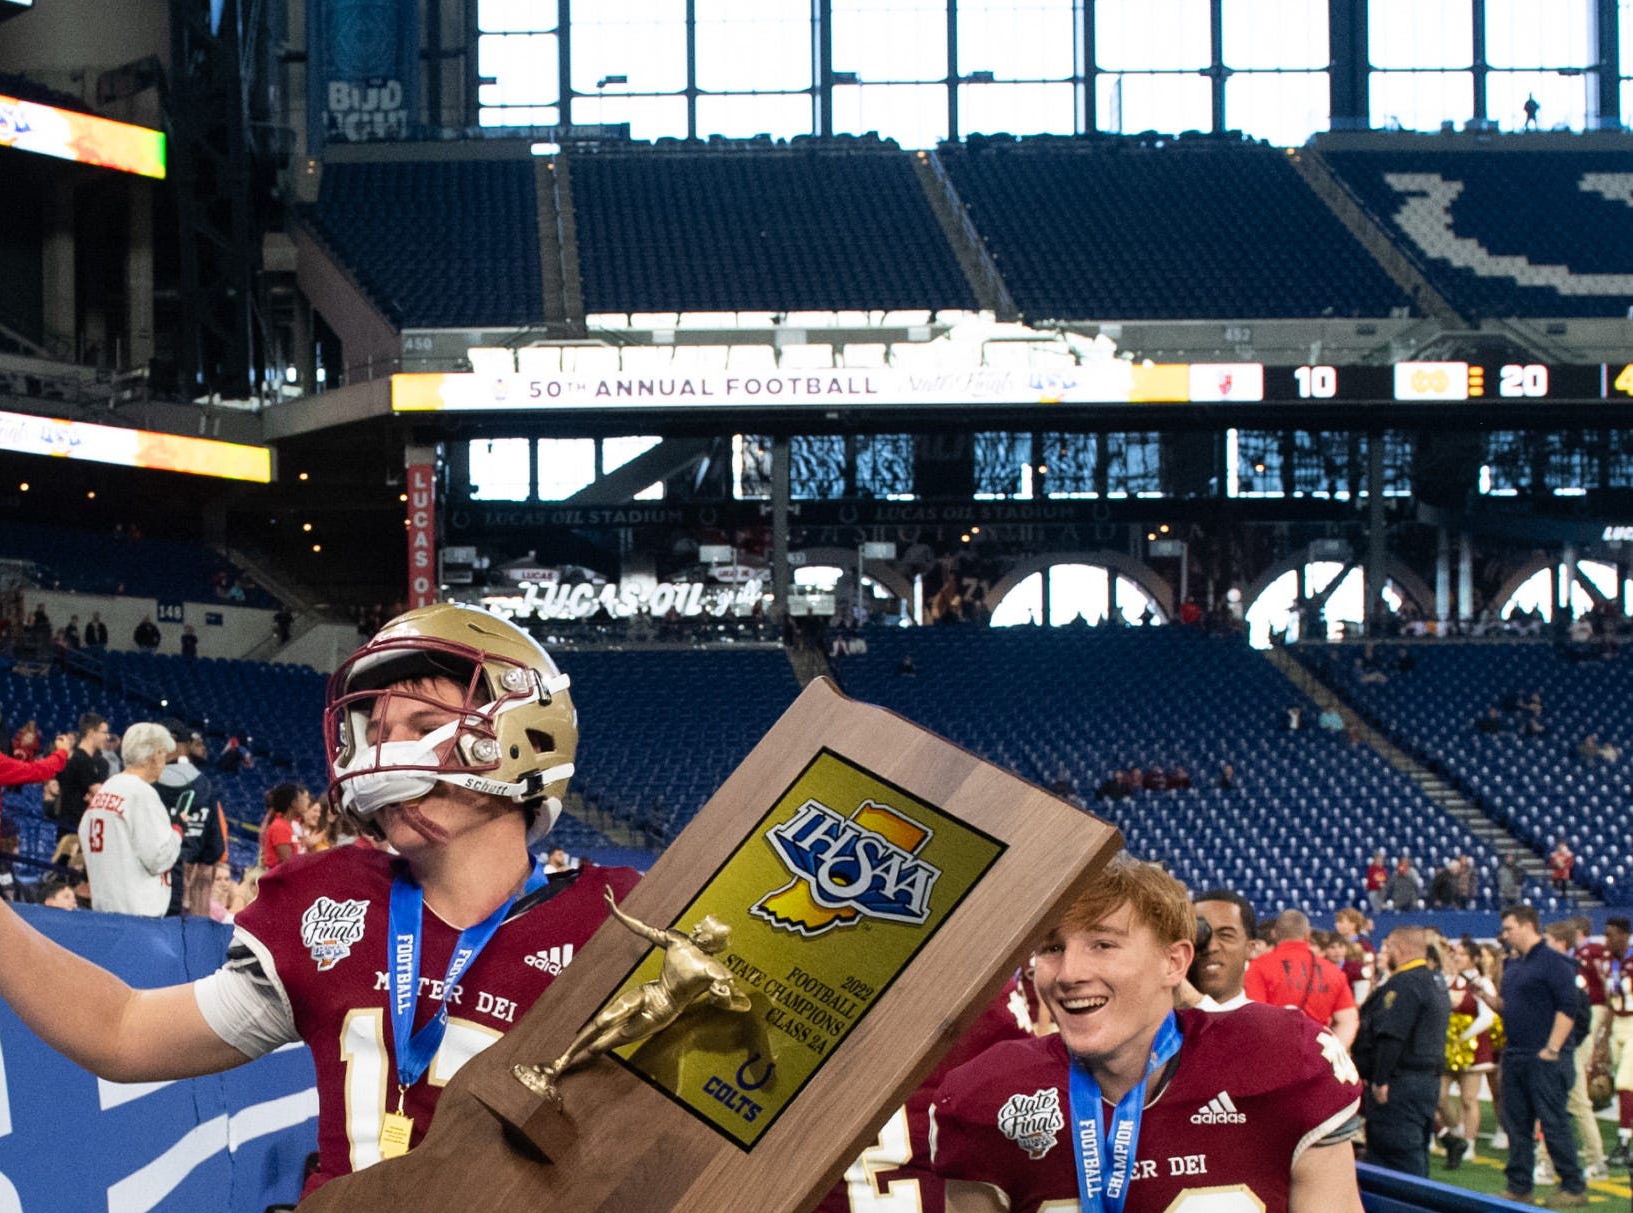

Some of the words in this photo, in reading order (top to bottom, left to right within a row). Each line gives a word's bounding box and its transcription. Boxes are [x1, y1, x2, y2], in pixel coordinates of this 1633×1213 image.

[328, 79, 402, 111] BUD
[529, 380, 586, 398] 50TH
[595, 378, 714, 397] ANNUAL
[726, 377, 879, 395] FOOTBALL
[1294, 366, 1337, 398] 10
[1499, 365, 1548, 397] 20
[412, 472, 429, 569] LUCAS
[158, 604, 183, 619] 148
[517, 581, 644, 619] LUCAS
[648, 581, 705, 617] OIL
[464, 777, 509, 794] schutt
[771, 799, 941, 923] IHSAA
[305, 899, 370, 922] State
[303, 917, 361, 945] Finals
[395, 933, 414, 1016] FOOTBALL
[523, 953, 565, 977] adid
[722, 952, 768, 989] STATE
[763, 978, 844, 1037] CHAMPIONS
[786, 967, 859, 1019] FOOTBALL
[844, 975, 874, 1001] 2022
[475, 990, 518, 1023] DEI
[765, 1008, 810, 1044] CLASS
[809, 1034, 829, 1055] 2A
[702, 1076, 763, 1124] COLTS
[1001, 1090, 1057, 1118] State
[1000, 1108, 1062, 1138] Finals
[1190, 1109, 1247, 1125] adidas
[1079, 1119, 1101, 1199] FOOTBALL
[1106, 1119, 1135, 1199] CHAMPION
[1170, 1154, 1207, 1175] DEI
